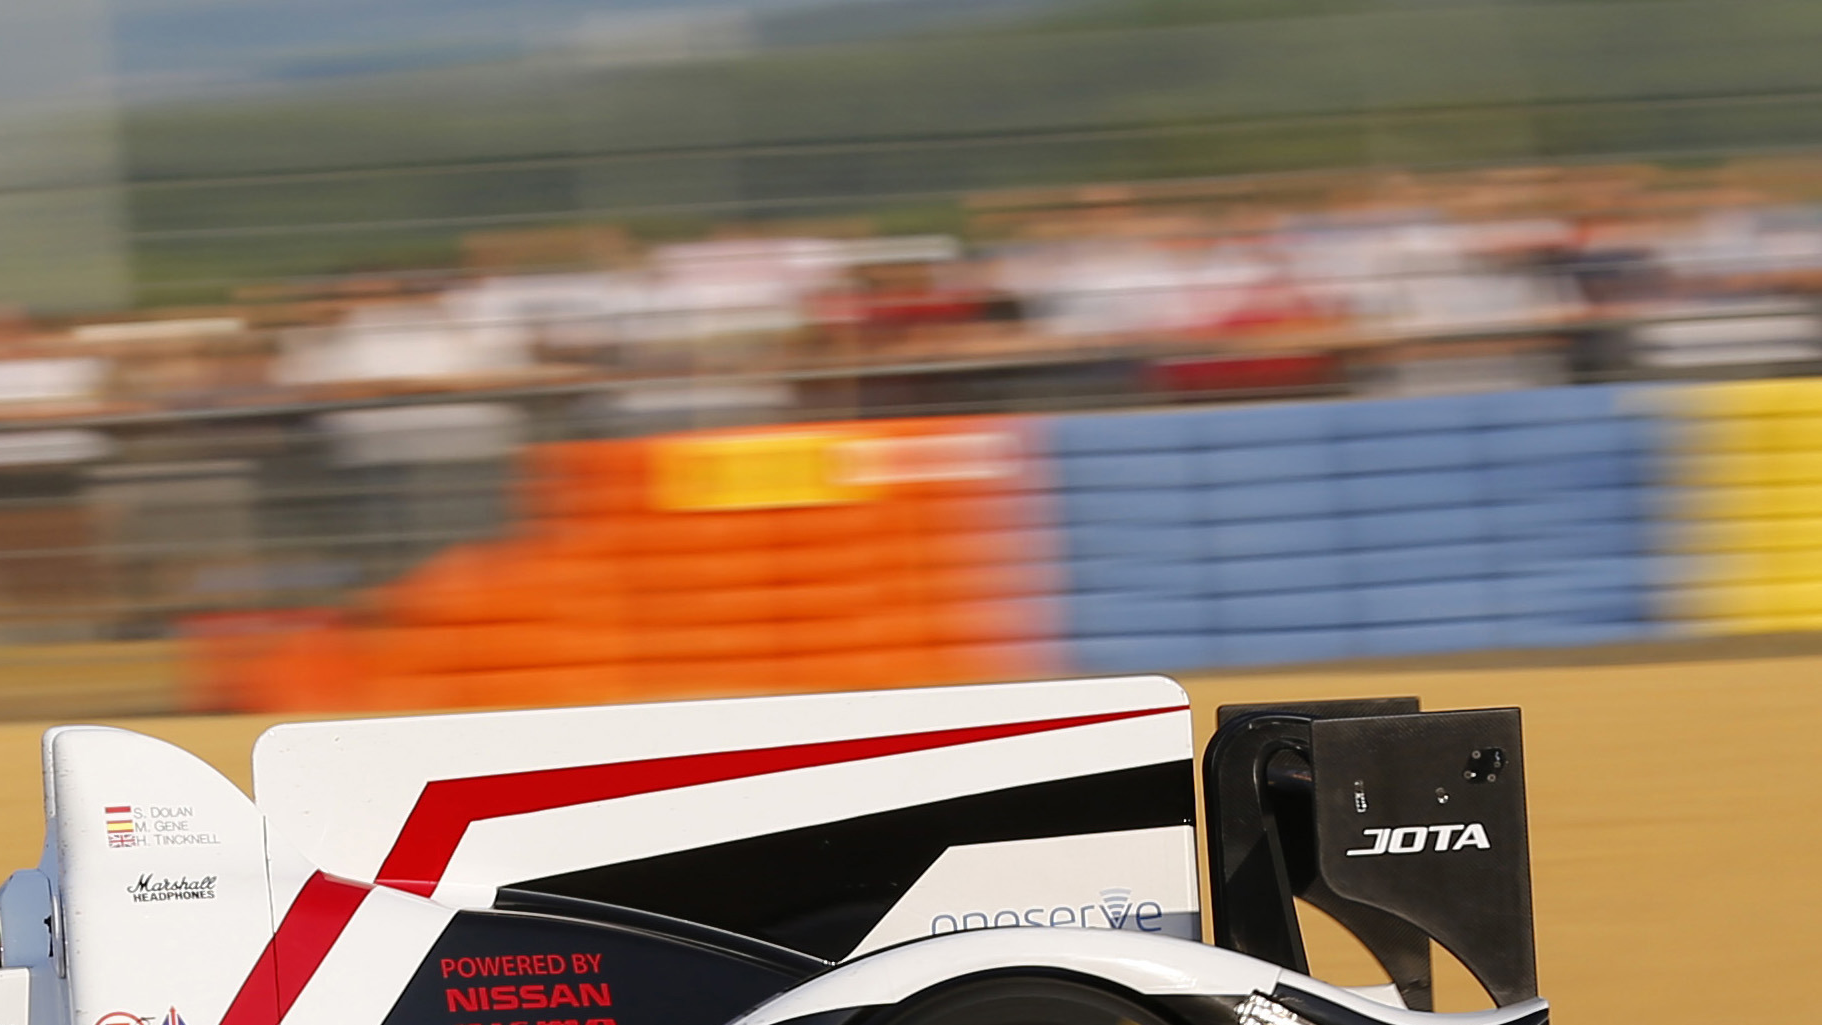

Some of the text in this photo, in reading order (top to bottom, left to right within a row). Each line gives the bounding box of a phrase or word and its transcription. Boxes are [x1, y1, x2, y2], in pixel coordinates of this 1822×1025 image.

[133, 806, 193, 819] S. DOLAN
[134, 820, 188, 833] M. GENE
[136, 834, 220, 846] H. TINCKNELL
[1346, 823, 1490, 856] JOTA
[127, 873, 217, 893] Marshall
[133, 890, 215, 902] HEADPHONES
[440, 953, 602, 978] POWERED BY
[446, 983, 612, 1012] NISSAN
